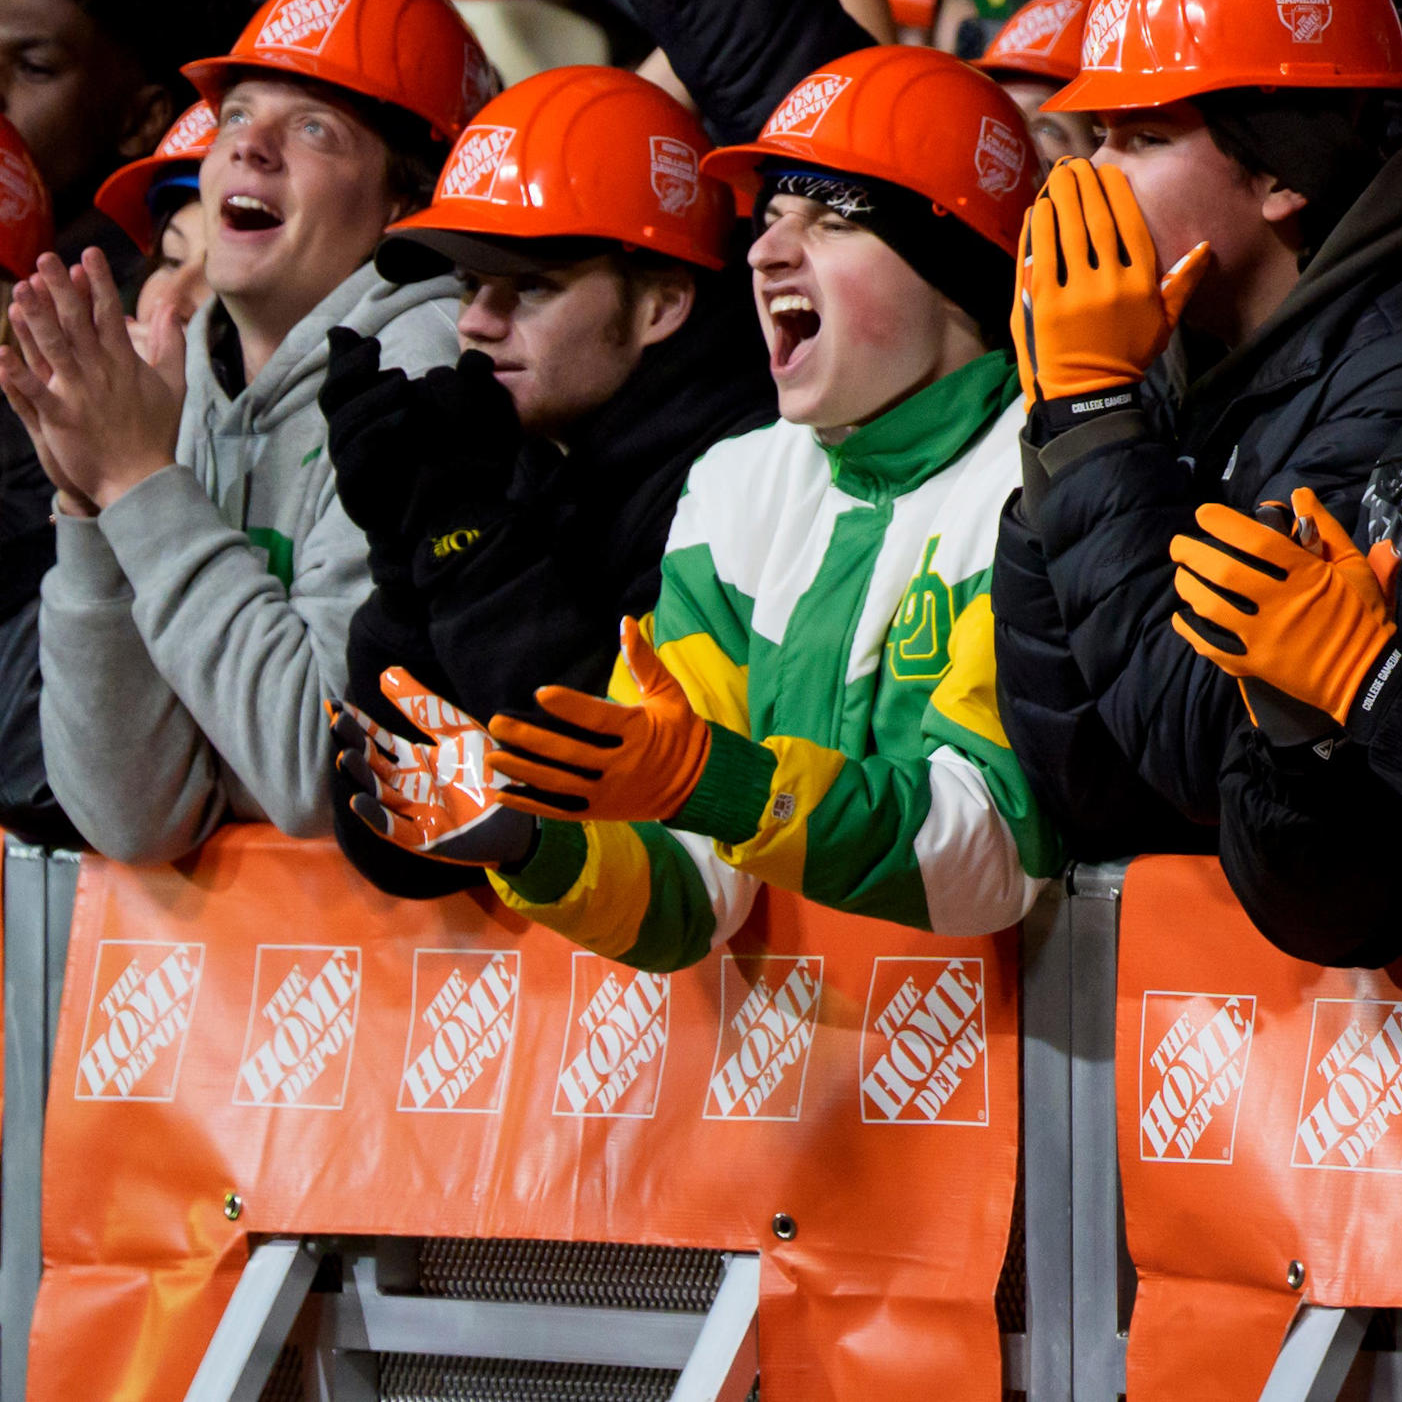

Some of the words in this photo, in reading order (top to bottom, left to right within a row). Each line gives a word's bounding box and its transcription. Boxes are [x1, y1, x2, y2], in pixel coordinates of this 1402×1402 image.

[281, 13, 333, 46] DEPOT
[768, 77, 842, 134] HOME
[783, 99, 829, 134] DEPOT
[444, 128, 511, 197] HOME
[460, 155, 500, 196] DEPOT
[1071, 399, 1105, 414] COLLEGE
[1361, 677, 1386, 712] COLLEGE
[79, 944, 200, 1097] HOME
[100, 958, 146, 1019] THE
[262, 965, 309, 1025] THE
[422, 969, 471, 1031] THE
[578, 972, 623, 1035] THE
[730, 975, 773, 1037] THE
[874, 976, 922, 1040] THE
[113, 1001, 191, 1097] DEPOT
[240, 948, 359, 1103] HOME
[277, 1007, 355, 1103] DEPOT
[402, 952, 518, 1109] HOME
[558, 971, 671, 1113] HOME
[709, 958, 822, 1116] HOME
[861, 960, 984, 1120] HOME
[1150, 1012, 1196, 1076] THE
[1316, 1021, 1369, 1084] THE
[440, 1012, 514, 1109] DEPOT
[597, 1017, 669, 1112] DEPOT
[743, 1018, 811, 1116] DEPOT
[914, 1020, 987, 1120] DEPOT
[1141, 997, 1251, 1158] HOME
[1174, 1058, 1245, 1159] DEPOT
